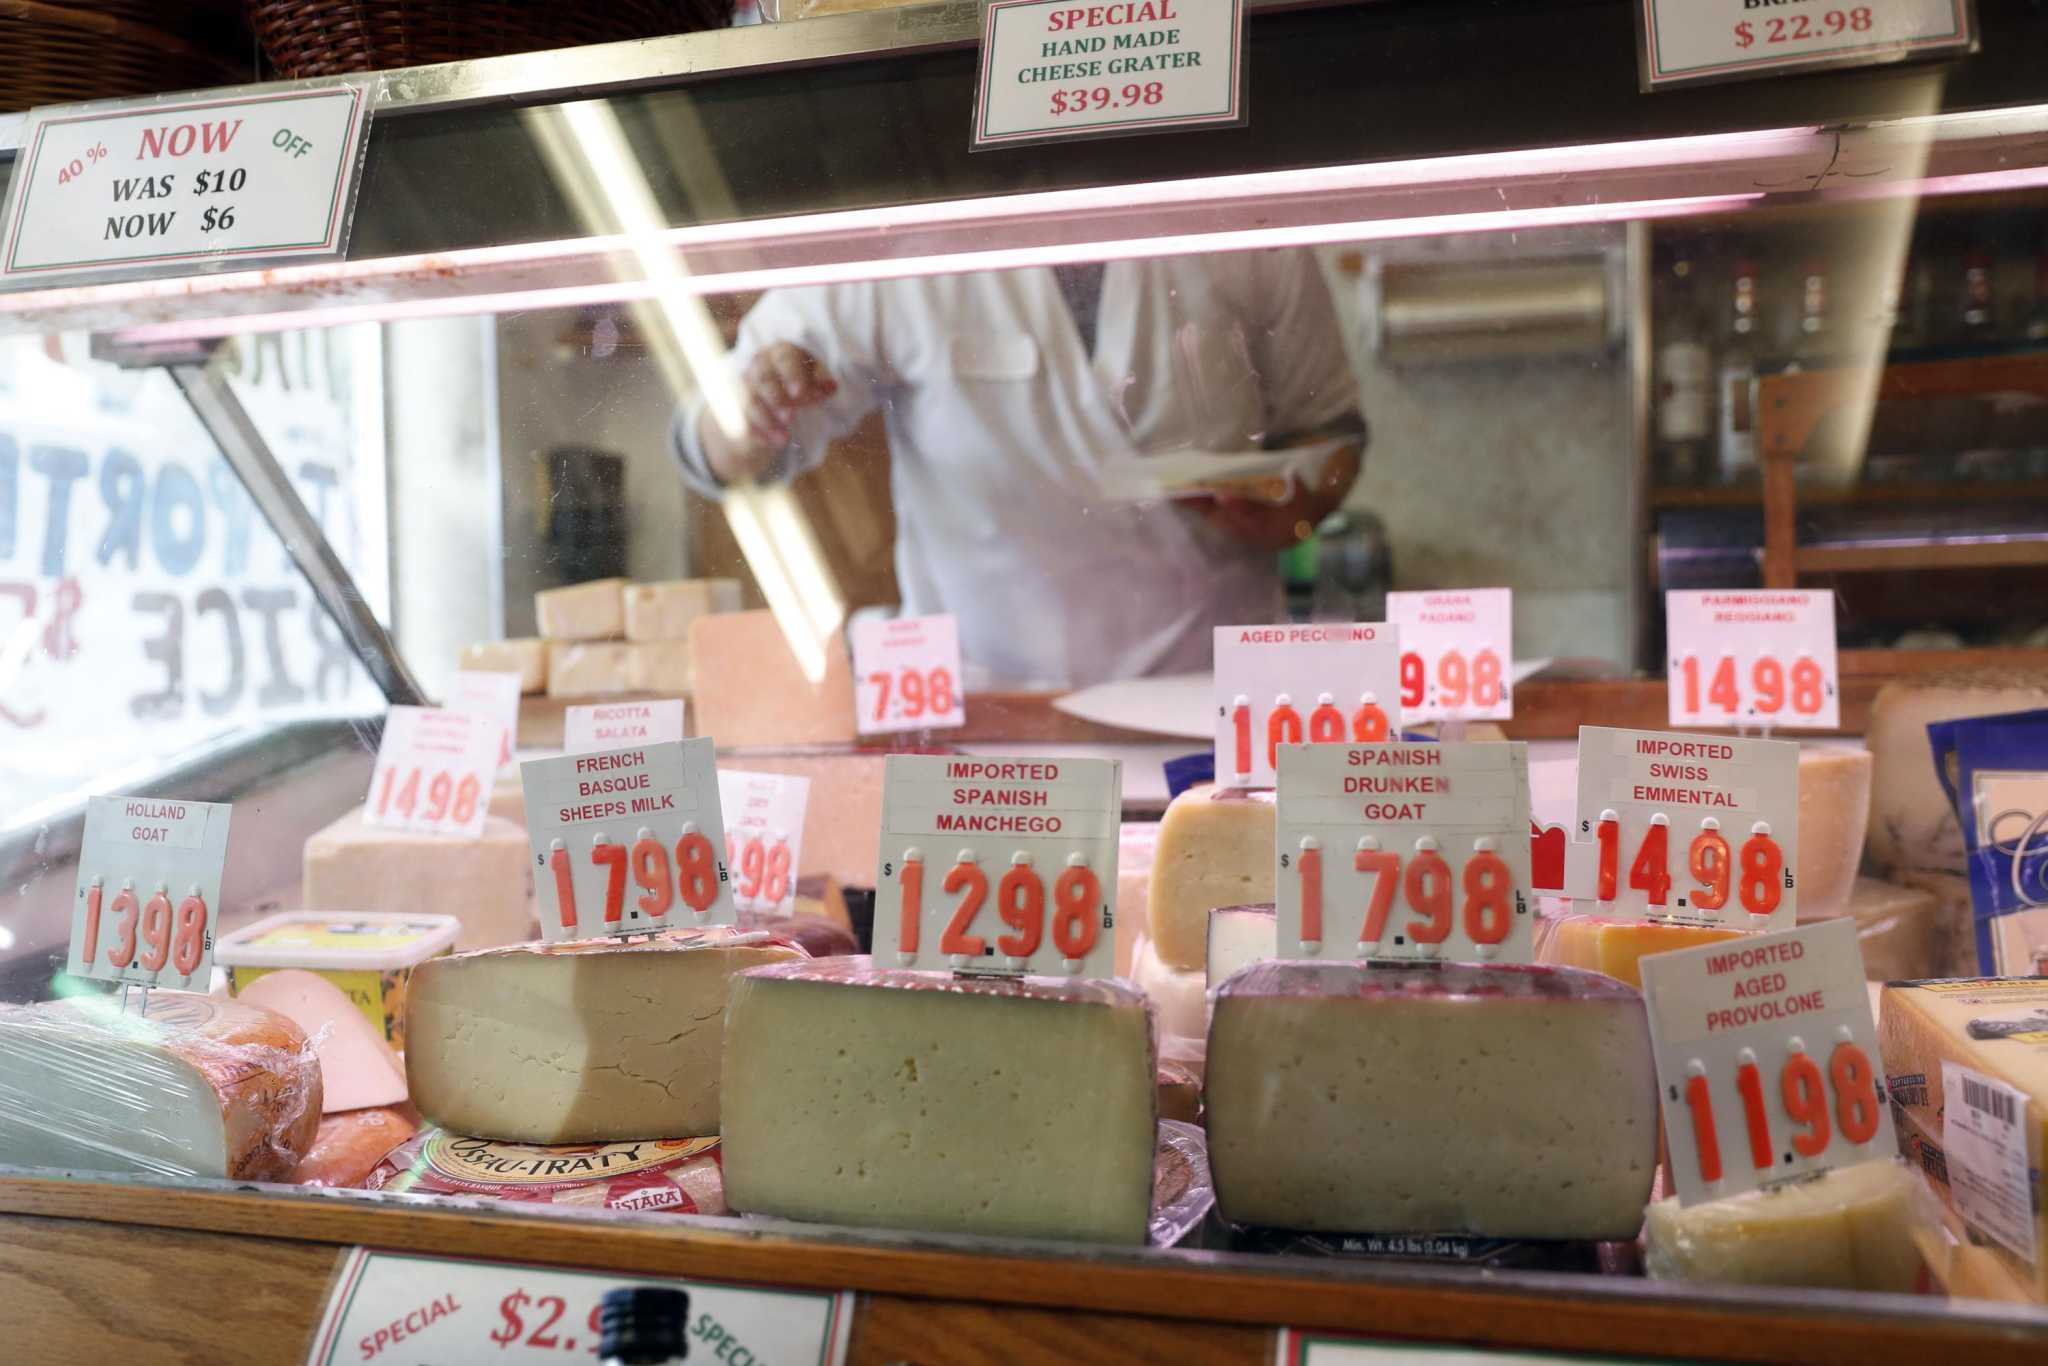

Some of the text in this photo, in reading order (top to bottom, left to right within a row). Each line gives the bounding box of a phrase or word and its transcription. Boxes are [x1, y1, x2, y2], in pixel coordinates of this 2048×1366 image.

[1048, 0, 1176, 32] SPECIAL
[1041, 29, 1180, 57] HAND MADE
[1018, 52, 1201, 83] CHEESE GRATER
[1050, 82, 1163, 116] $39.98
[136, 119, 243, 160] NOW
[272, 128, 313, 159] OFF
[57, 159, 83, 185] 40
[112, 168, 247, 201] WAS $10
[104, 206, 235, 240] NOW $6
[1240, 630, 1285, 643] AGED
[869, 667, 954, 721] 7.98
[1683, 656, 1822, 715] 14.98
[592, 706, 652, 721] RICOTTA
[576, 751, 646, 774] FRENCH
[1348, 749, 1441, 766] SPANISH
[1636, 739, 1734, 761] IMPORTED
[578, 774, 651, 797] BASQUE
[947, 762, 1059, 781] IMPORTED
[1344, 776, 1449, 794] DRUNKEN
[1650, 763, 1709, 782] SWISS
[126, 802, 187, 820] HOLLAND
[559, 793, 675, 823] SHEEPS MILK
[953, 788, 1048, 806] SPANISH
[1364, 803, 1427, 820] GOAT
[1633, 785, 1739, 808] EMMENTAL
[131, 826, 169, 843] GOAT
[936, 814, 1063, 833] MANCHEGO
[537, 853, 545, 866] $
[551, 832, 719, 929] 17.98
[1581, 820, 1590, 833] $
[1597, 820, 1783, 915] 14.98
[884, 862, 893, 877] $
[900, 861, 1101, 960] 12.98
[1280, 853, 1290, 869] $
[1297, 849, 1512, 946] 17.98
[81, 885, 207, 977] 13.98
[1706, 940, 1805, 976] IMPORTED
[1733, 973, 1788, 999] AGED
[1706, 991, 1825, 1032] PROVOLONE
[1685, 1040, 1881, 1183] 11.98
[359, 1292, 463, 1362] SPECIAL
